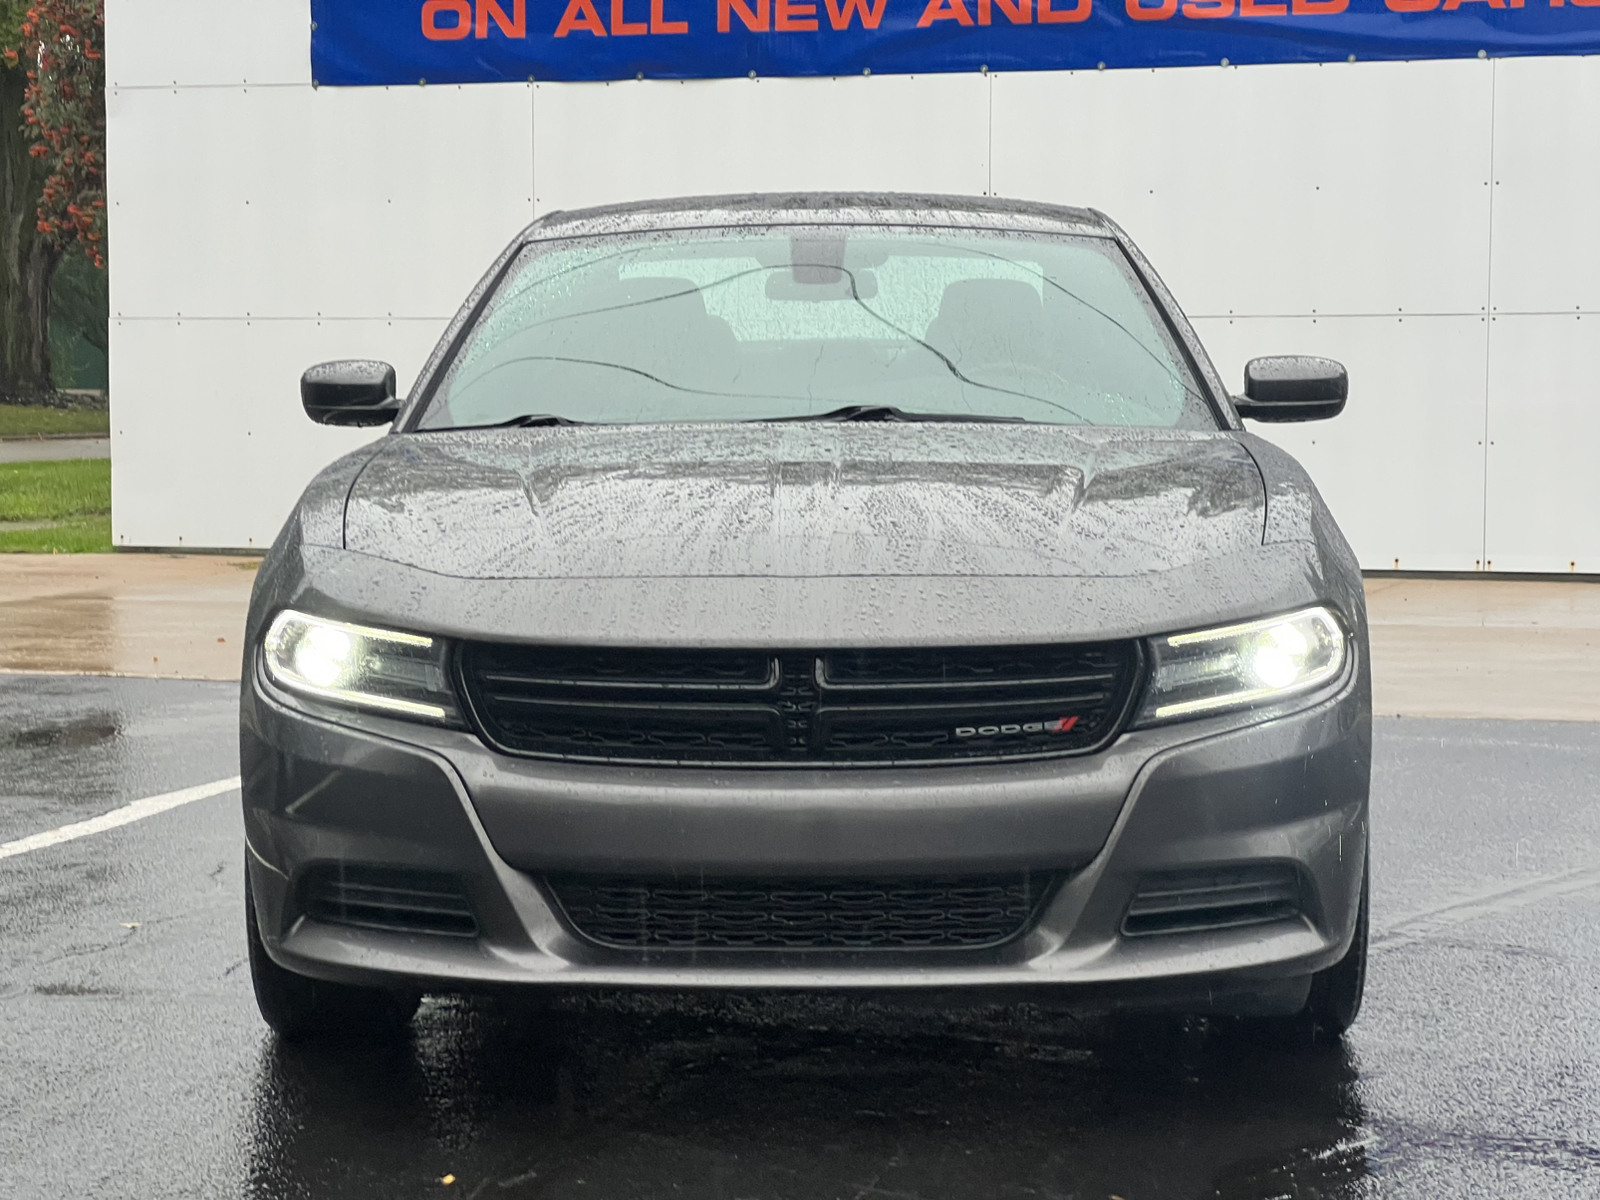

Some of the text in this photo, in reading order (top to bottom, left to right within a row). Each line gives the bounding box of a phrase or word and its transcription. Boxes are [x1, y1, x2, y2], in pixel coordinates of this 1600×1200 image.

[421, 0, 526, 41] ON
[554, 0, 689, 38] ALL
[717, 0, 888, 33] NEW
[955, 720, 1061, 737] DODGE
